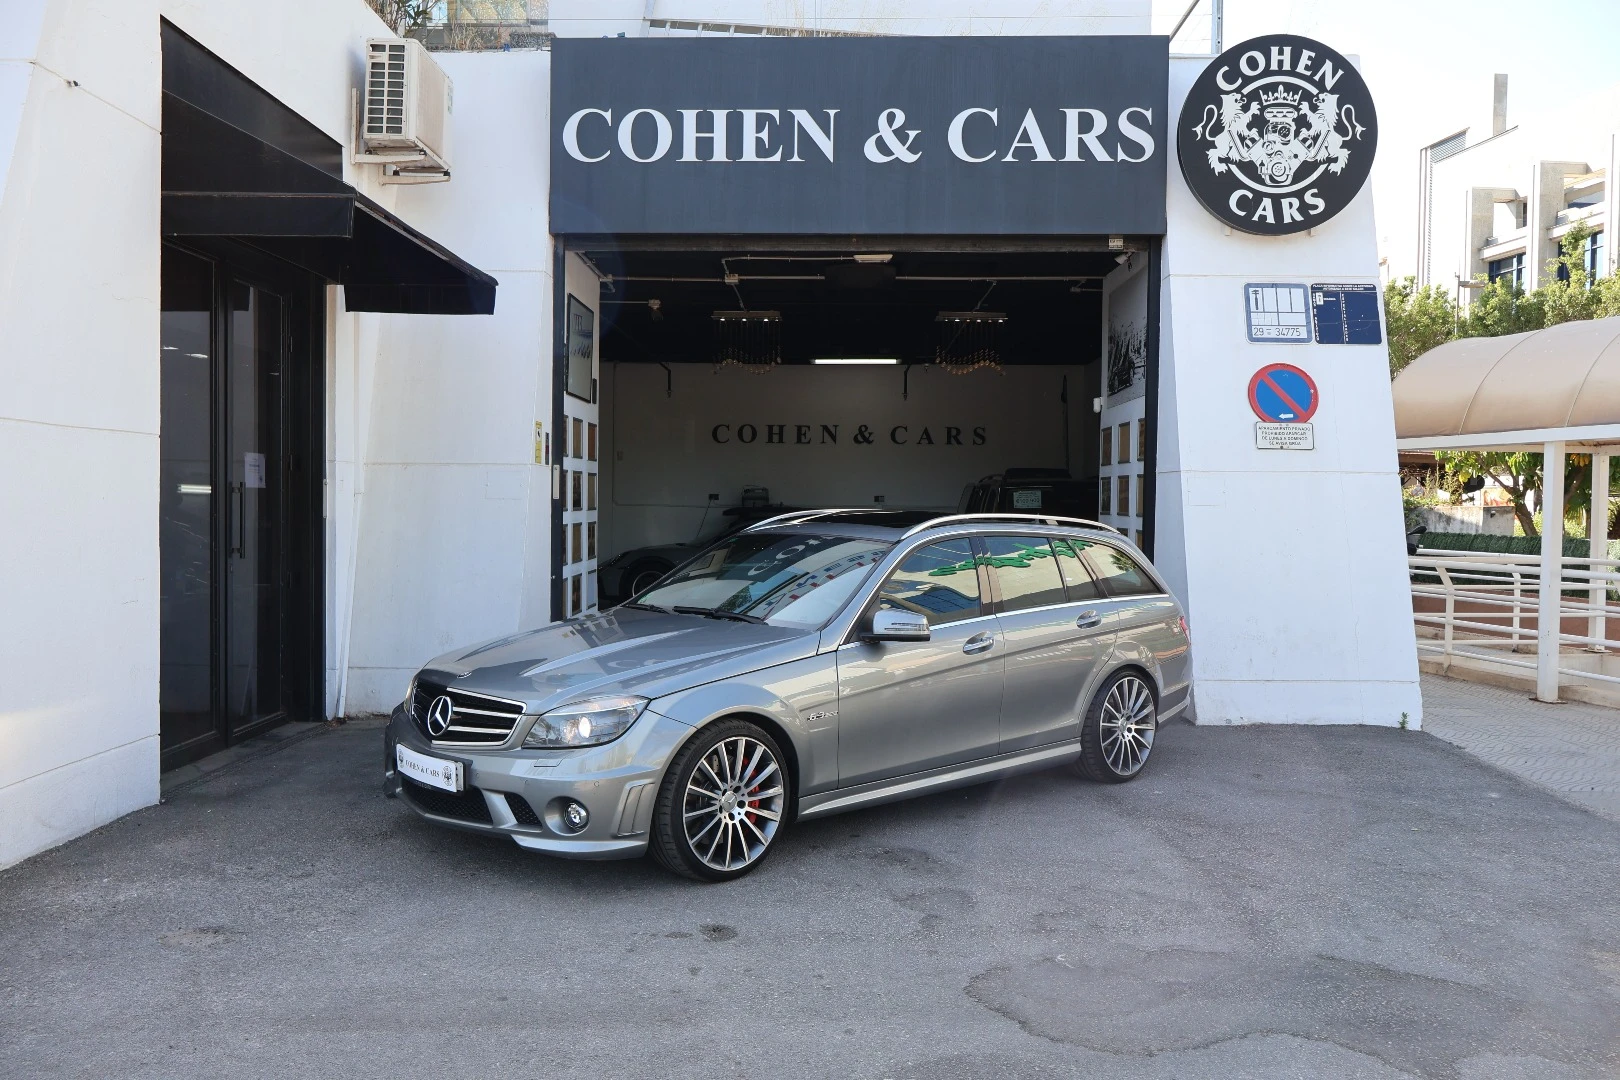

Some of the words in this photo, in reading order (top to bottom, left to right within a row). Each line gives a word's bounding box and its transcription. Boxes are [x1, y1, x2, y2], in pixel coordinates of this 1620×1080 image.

[1216, 46, 1344, 91] COHEN
[562, 108, 840, 163] COHEN
[863, 108, 922, 163] &
[947, 107, 1155, 163] CARS
[1228, 188, 1326, 224] CARS
[1253, 327, 1264, 336] 29
[1274, 327, 1301, 337] 34775
[711, 423, 839, 445] COHEN
[853, 423, 875, 445] &
[889, 425, 987, 446] CARS
